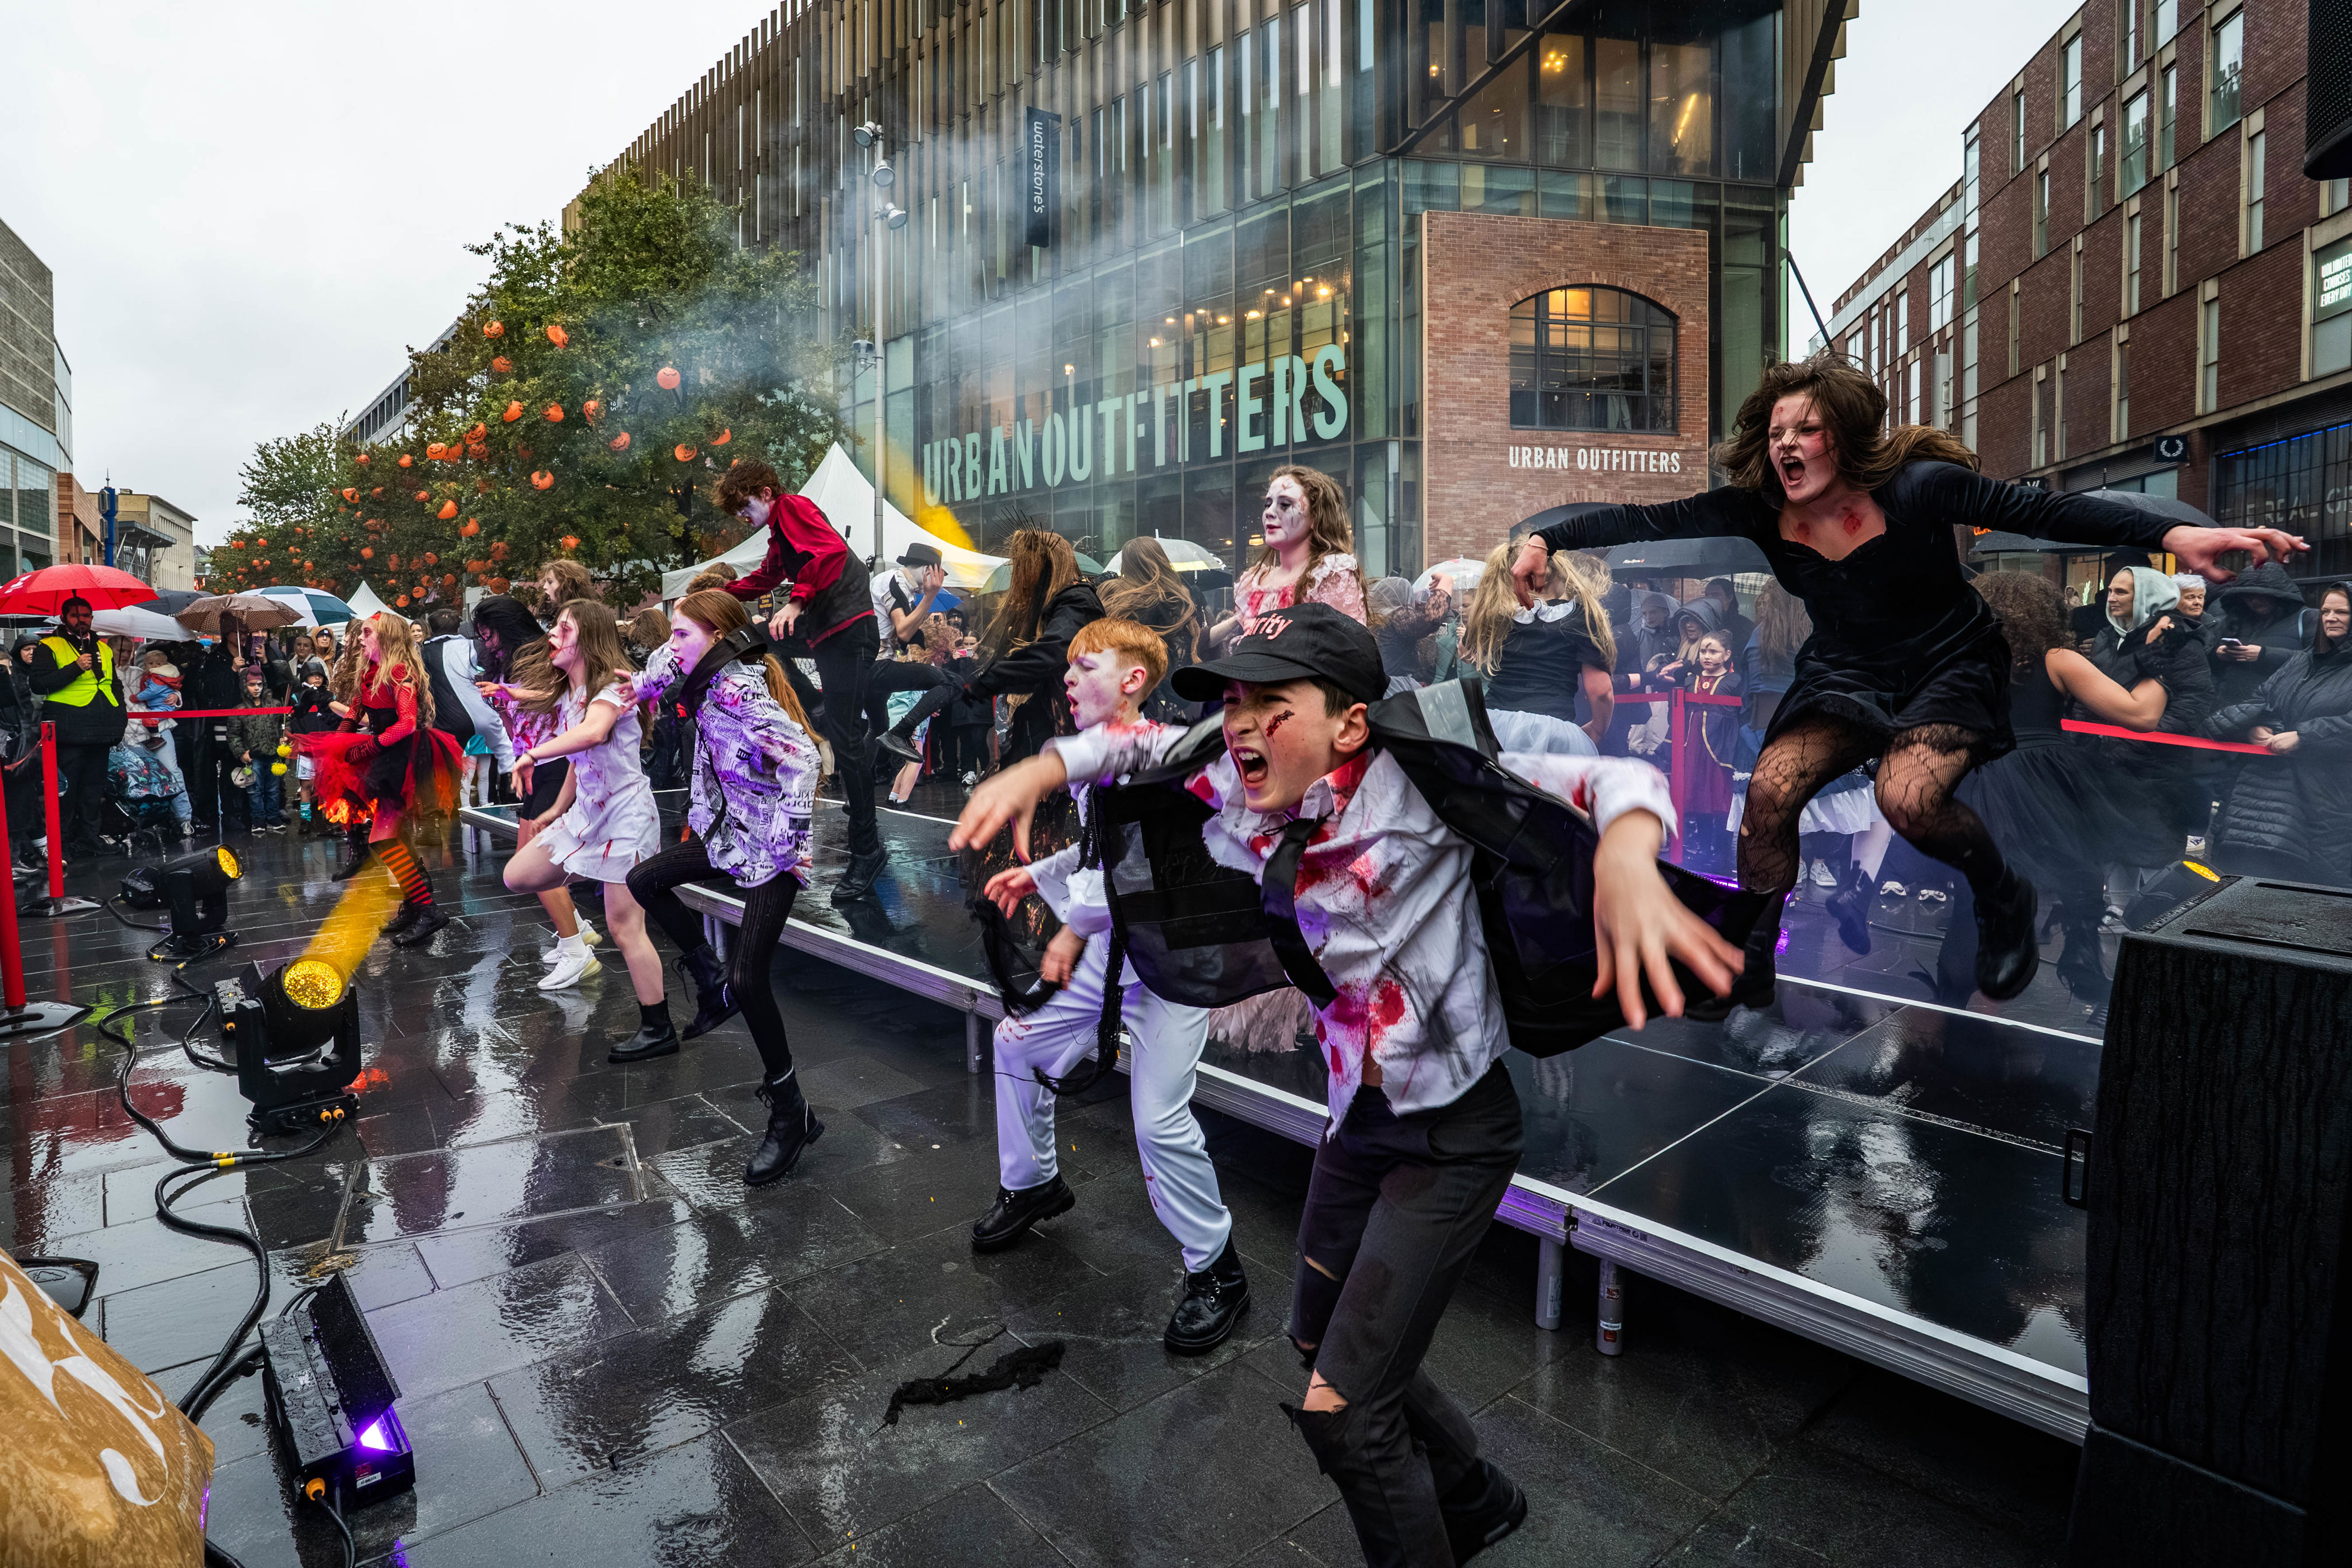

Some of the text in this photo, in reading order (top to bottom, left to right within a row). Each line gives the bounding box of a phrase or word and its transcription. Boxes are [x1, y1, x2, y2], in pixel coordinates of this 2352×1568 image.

[1034, 121, 1045, 214] waterstone's
[2321, 253, 2352, 278] UNLIMITED
[2323, 270, 2351, 291] COURSES
[2320, 282, 2352, 307] EVERY DAY
[923, 344, 1348, 507] URBAN OUTFITTERS
[1509, 446, 1680, 473] URBAN OUTFITTERS
